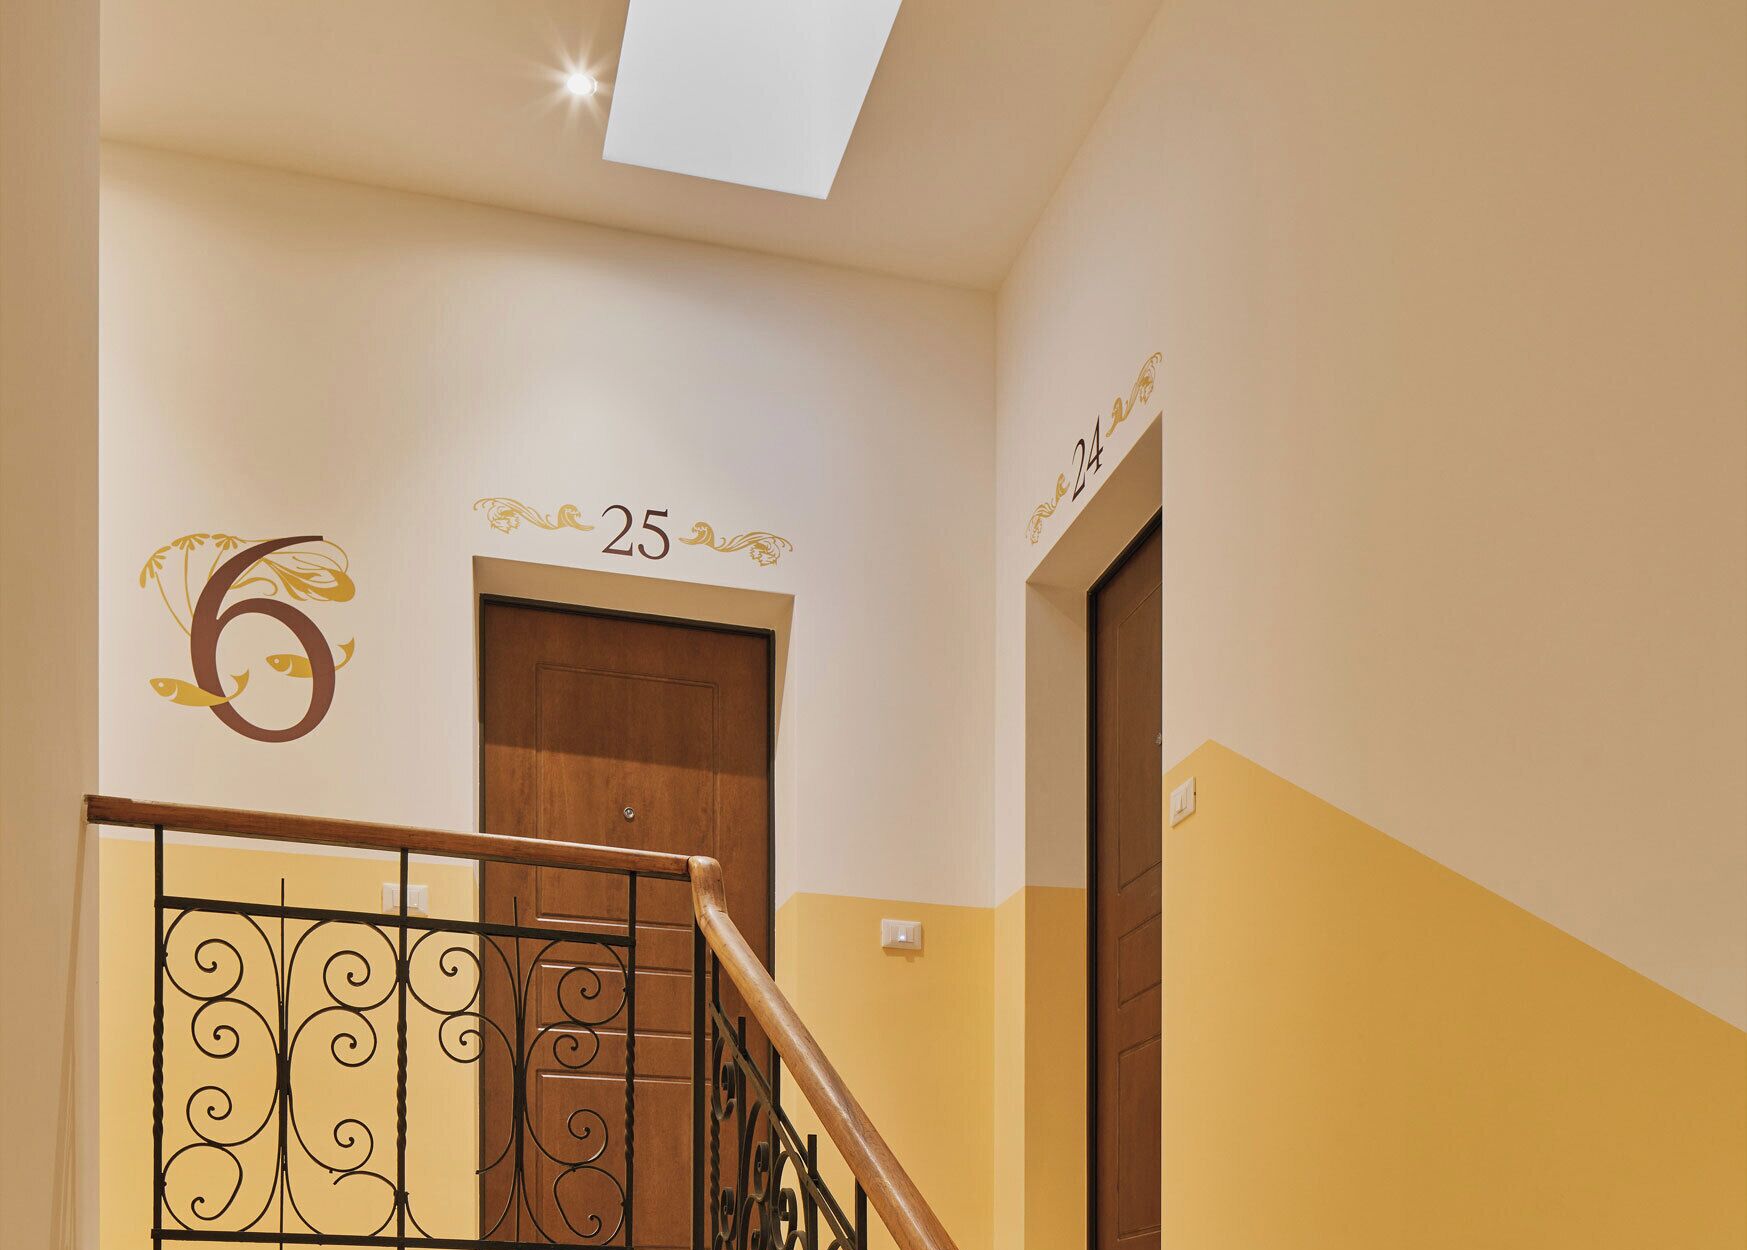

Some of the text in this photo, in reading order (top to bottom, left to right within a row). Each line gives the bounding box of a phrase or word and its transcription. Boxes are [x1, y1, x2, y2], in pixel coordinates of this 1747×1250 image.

[1072, 415, 1104, 503] 24
[601, 504, 671, 561] 25
[190, 535, 336, 744] 6
